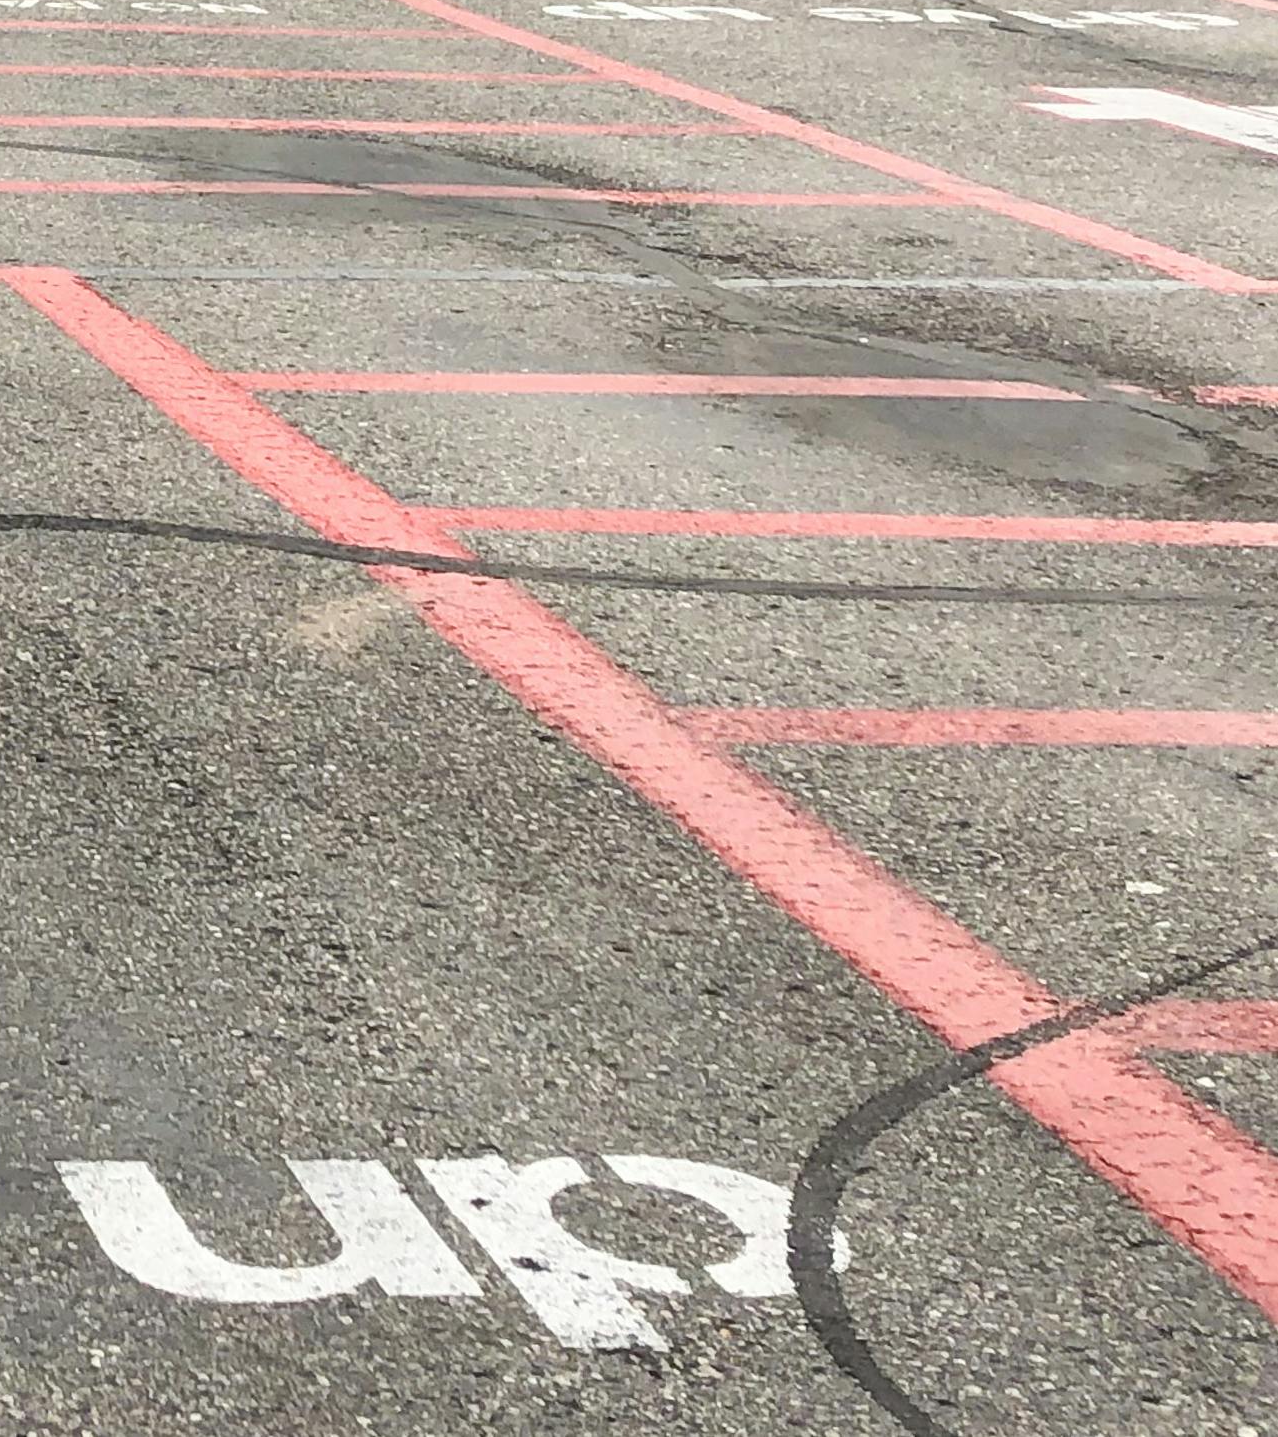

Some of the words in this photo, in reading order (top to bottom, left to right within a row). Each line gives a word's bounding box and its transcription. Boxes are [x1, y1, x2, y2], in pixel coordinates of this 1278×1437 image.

[130, 0, 268, 14] NO
[542, 1, 773, 23] up
[809, 6, 1239, 32] drive
[54, 1154, 849, 1353] up
